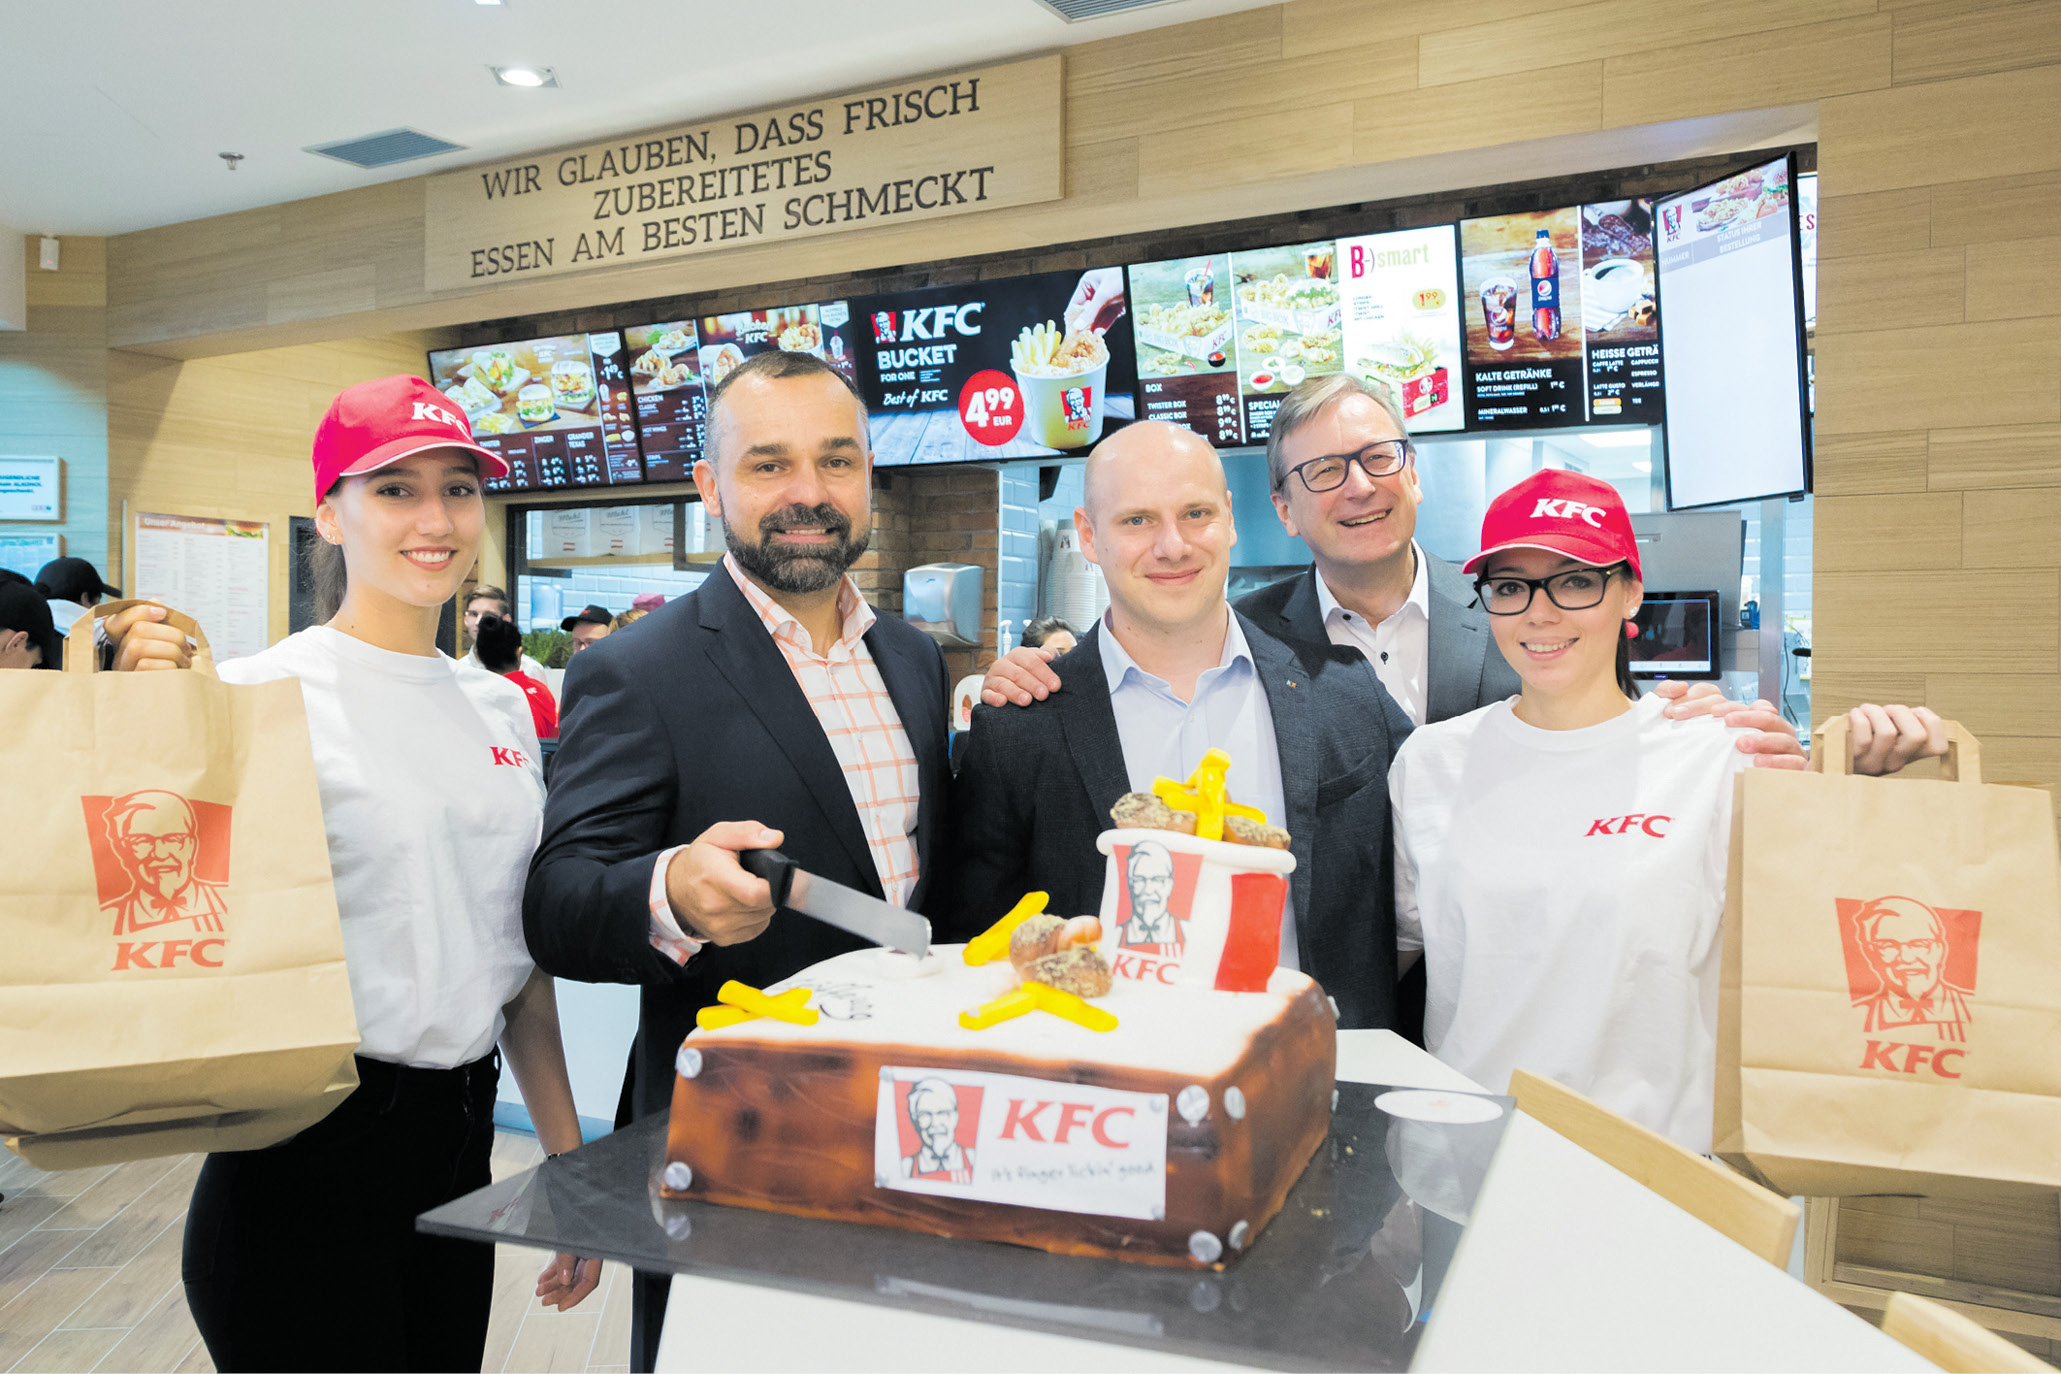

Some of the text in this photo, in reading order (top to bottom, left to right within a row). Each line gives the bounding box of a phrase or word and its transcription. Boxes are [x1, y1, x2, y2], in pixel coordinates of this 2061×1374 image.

[482, 78, 980, 199] WIR GLAUBEN, DASS FRISCH
[593, 150, 833, 220] ZUBEREITETES
[470, 166, 994, 278] ESSEN AM BESTEN SCHMECKT
[1666, 233, 1680, 243] KFC
[1717, 228, 1741, 243] STATUS
[1719, 234, 1761, 254] BESTELLUNG
[1377, 243, 1429, 268] smart
[1661, 251, 1690, 266] NUMMER
[900, 302, 984, 342] KFC
[744, 332, 768, 344] KFC
[877, 344, 957, 370] BUCKET
[1592, 348, 1625, 359] HEISSE
[880, 373, 897, 383] FOR
[898, 371, 916, 381] ONE
[1475, 368, 1552, 381] KALTE GETRÄNKE
[1145, 383, 1163, 393] BOX
[1513, 383, 1538, 391] (REFILL)
[637, 394, 664, 403] CHICKEN
[883, 388, 949, 408] Best of KFC
[1147, 400, 1187, 410] TWISTER BOX
[1148, 411, 1187, 420] CLASSIC BOX
[1478, 406, 1528, 415] MINERALWASSER
[993, 415, 1012, 427] EUR
[1067, 420, 1091, 431] KFC
[1529, 498, 1606, 528] KFC
[1583, 813, 1672, 838] KFC
[110, 938, 225, 972] KFC
[1112, 954, 1180, 985] KFC
[1858, 1039, 1965, 1079] KFC
[998, 1098, 1135, 1149] KFC
[1119, 1161, 1154, 1182] good
